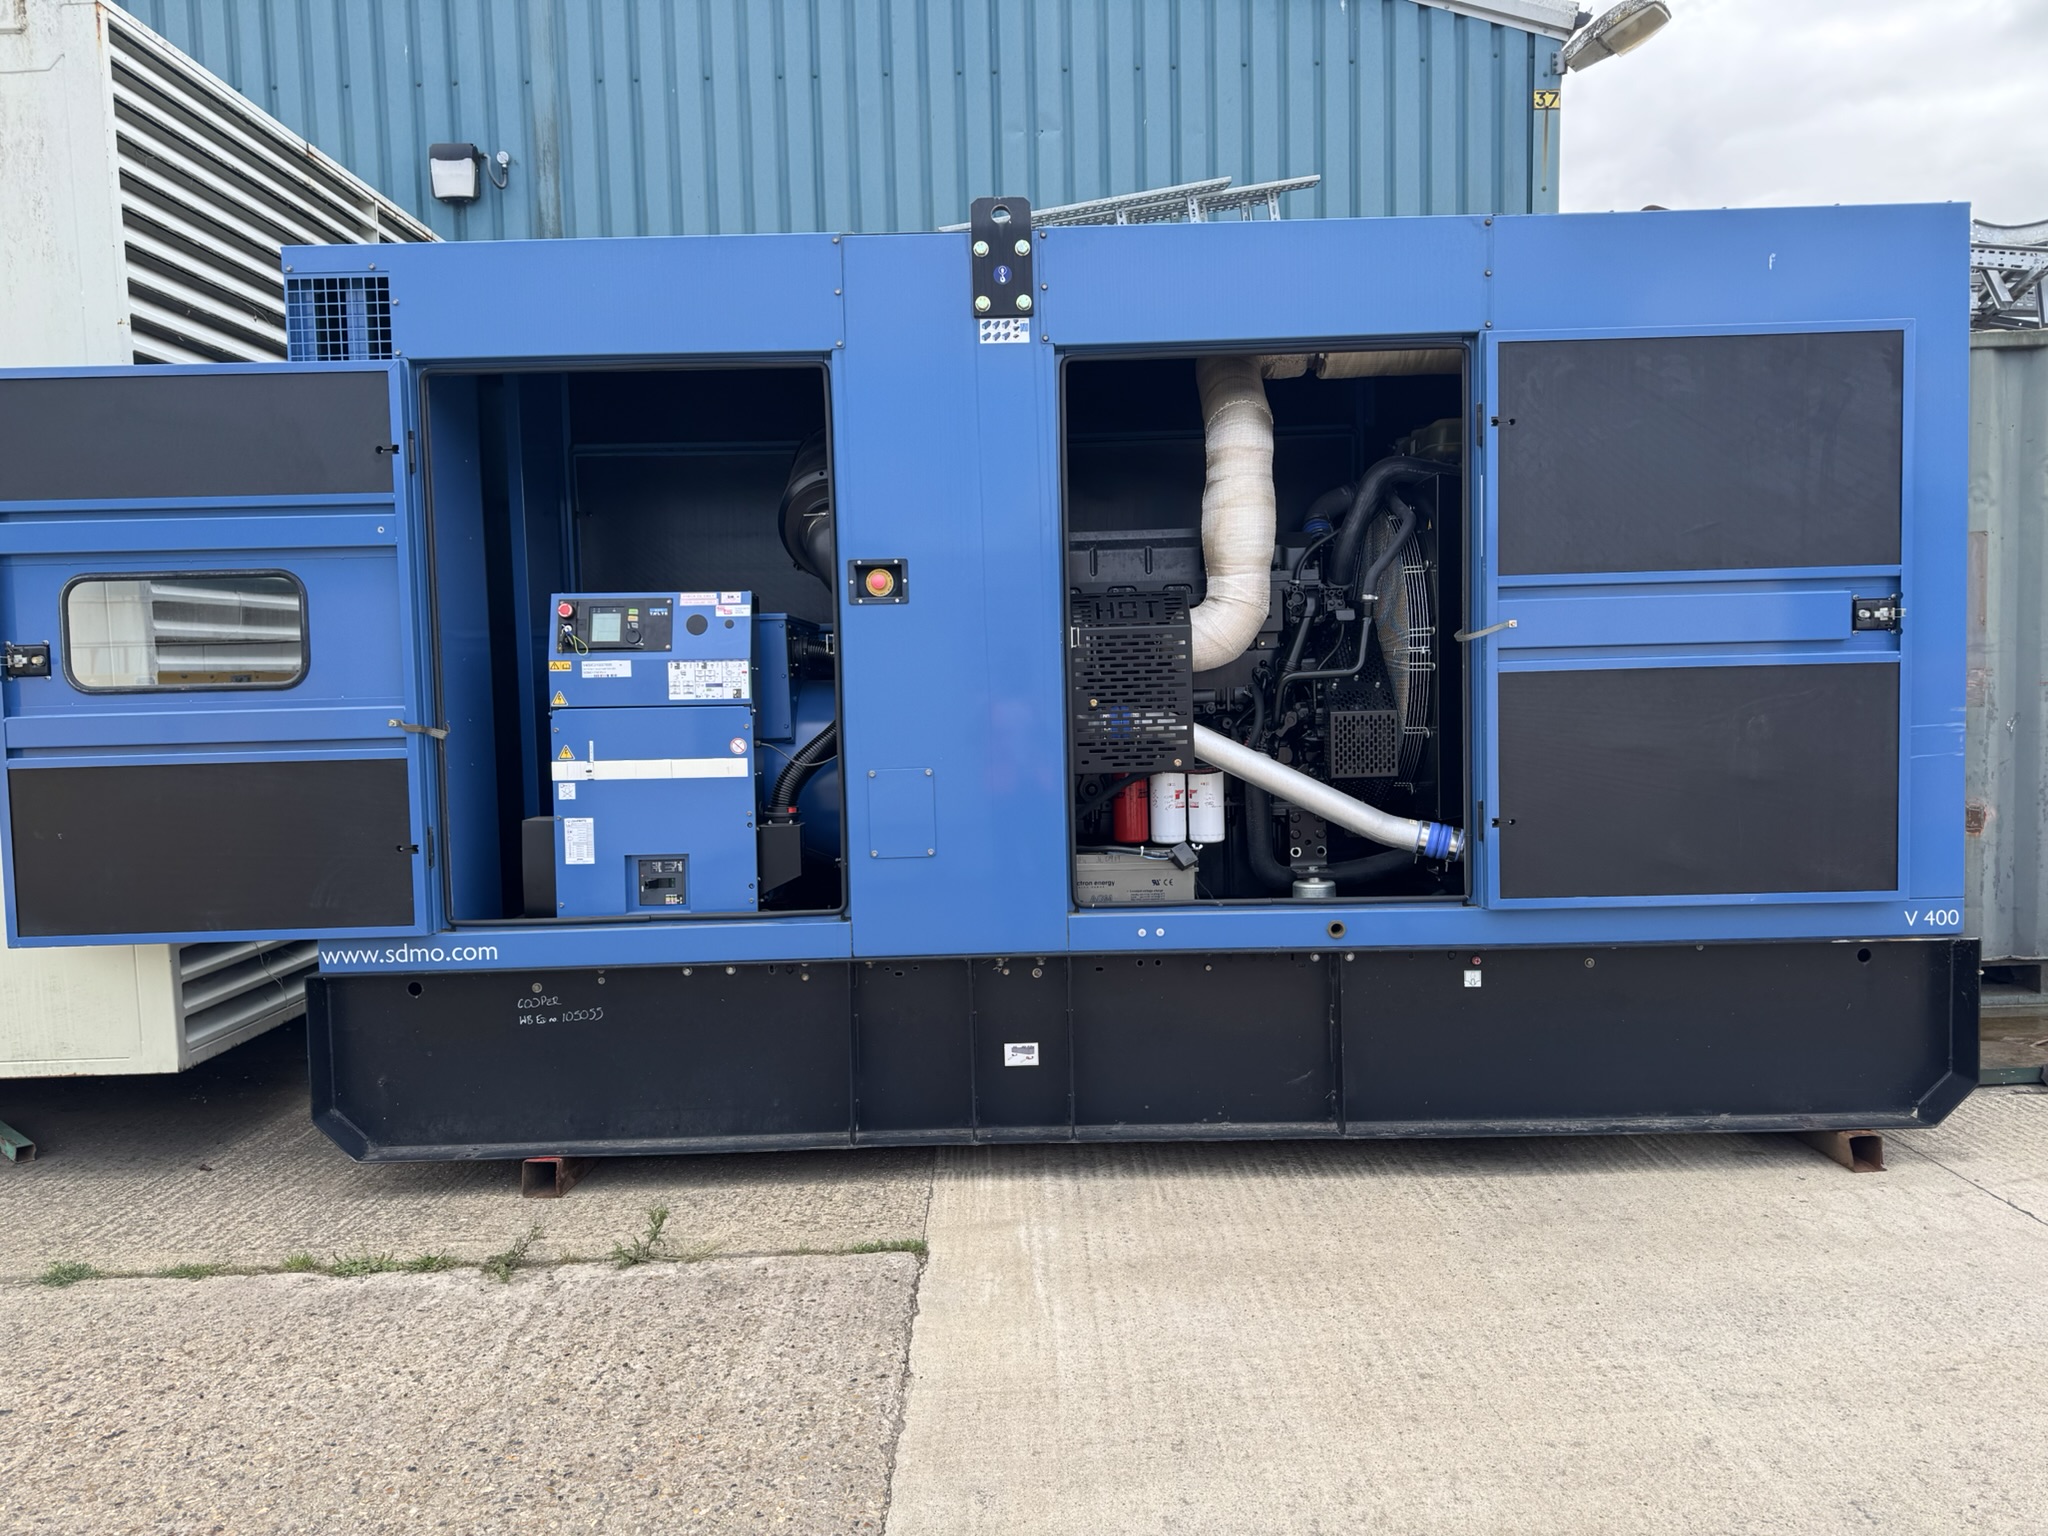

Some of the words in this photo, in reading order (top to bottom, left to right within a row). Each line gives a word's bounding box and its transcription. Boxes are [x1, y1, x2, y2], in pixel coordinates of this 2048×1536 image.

[1535, 91, 1559, 107] 37
[1095, 600, 1159, 619] HOT
[1904, 910, 1918, 926] V
[1923, 909, 1960, 926] 400
[321, 943, 498, 965] www.sdmo.com
[517, 995, 562, 1009] COOPER
